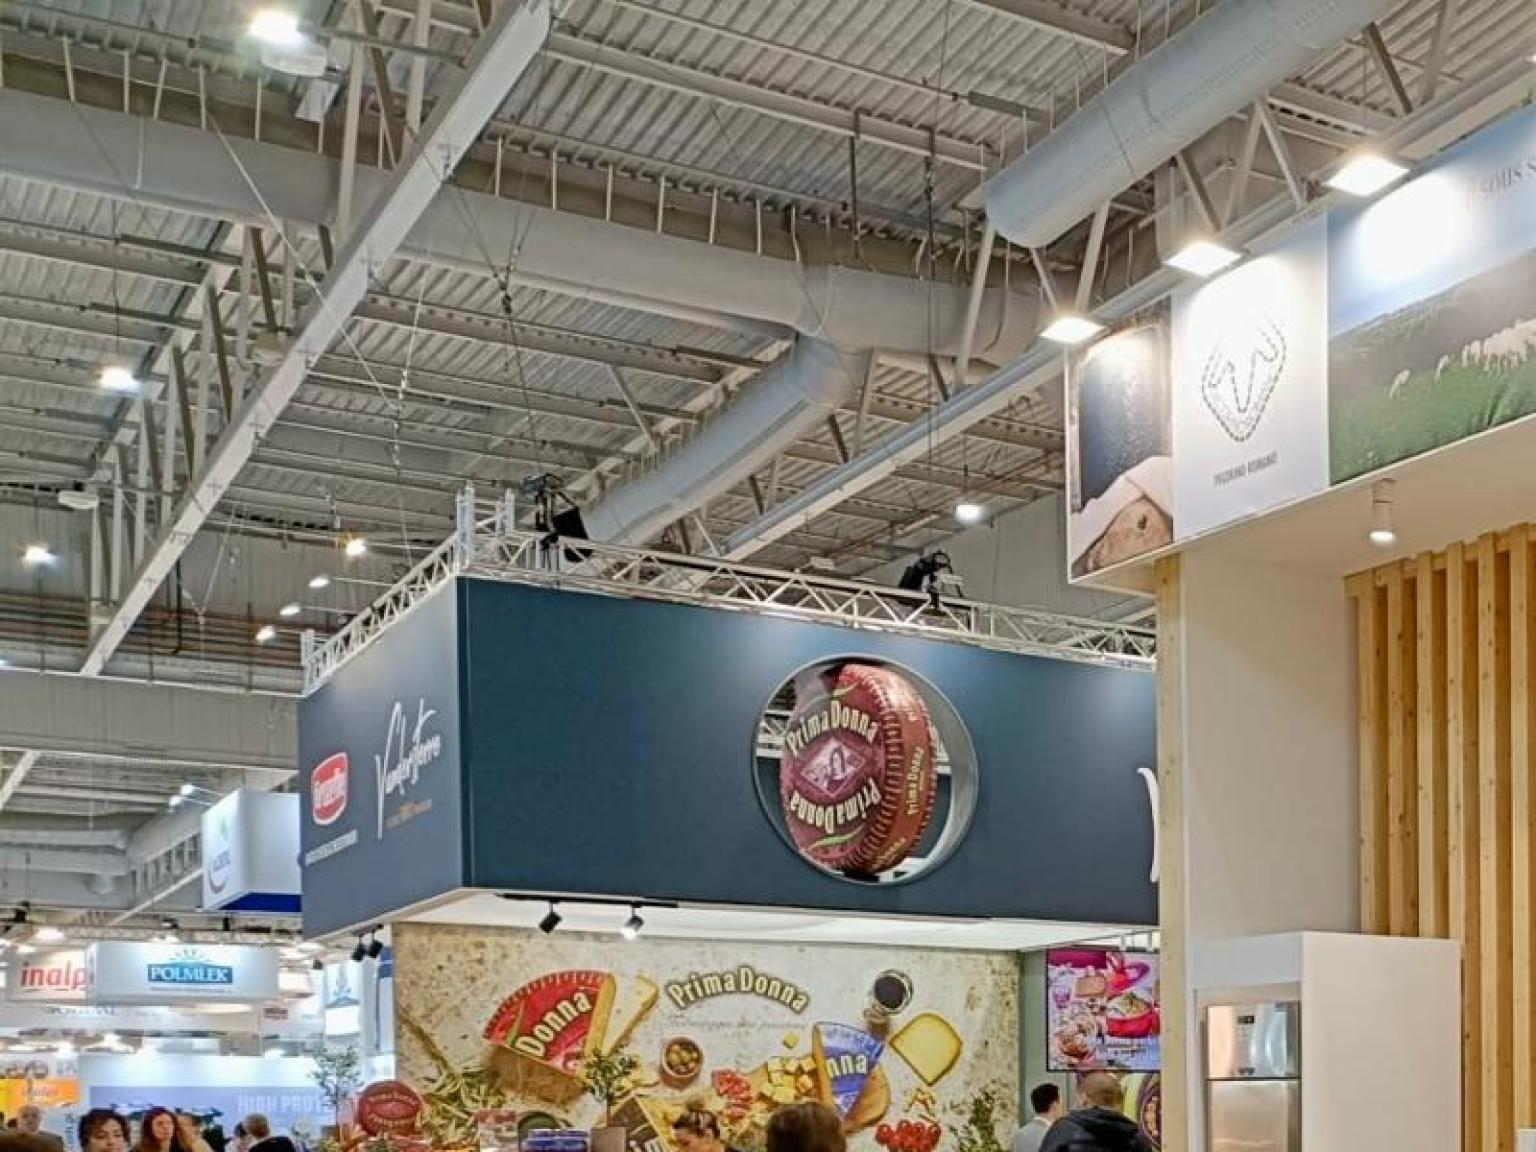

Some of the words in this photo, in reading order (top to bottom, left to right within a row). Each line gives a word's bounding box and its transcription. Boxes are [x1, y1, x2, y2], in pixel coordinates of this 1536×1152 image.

[786, 711, 829, 757] Prima
[830, 699, 879, 743] Donna
[790, 790, 835, 833] Donna
[836, 777, 882, 824] Prima
[150, 966, 229, 982] POLMLEK
[668, 971, 736, 1008] Prima
[739, 966, 810, 1013] Donna
[514, 991, 593, 1057] Donna
